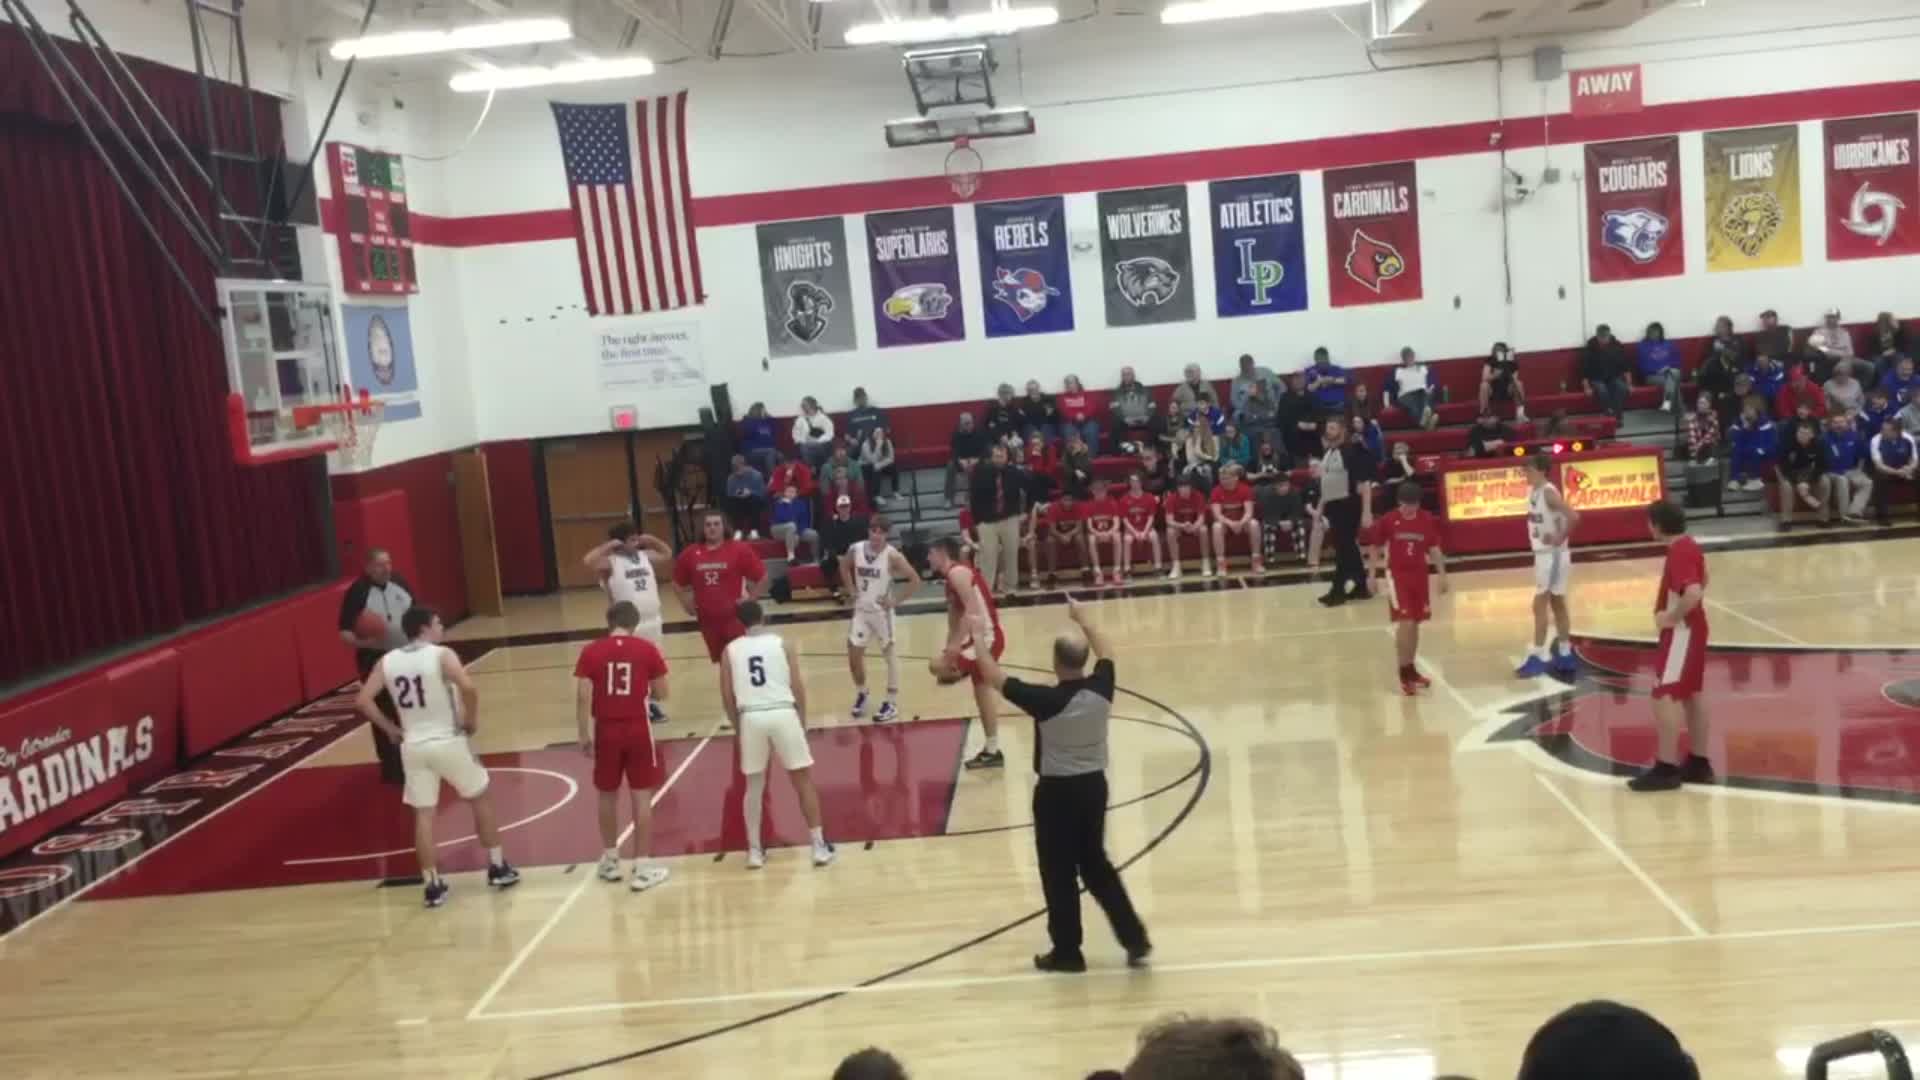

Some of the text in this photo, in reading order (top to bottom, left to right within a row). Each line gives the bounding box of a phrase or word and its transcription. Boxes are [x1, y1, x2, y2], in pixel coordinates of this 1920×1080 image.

[1577, 72, 1633, 96] AWAY
[1730, 151, 1774, 180] LIONS
[1834, 138, 1910, 170] HURRICANES
[1599, 160, 1667, 192] COUGARS
[1220, 197, 1294, 229] ATHLETICS
[1333, 186, 1409, 219] CARDINALS
[994, 221, 1049, 251] REBELS
[1106, 208, 1182, 240] WOLVERINES
[773, 242, 833, 272] KNIGHTS
[875, 230, 949, 261] SUPERLARKS
[704, 571, 720, 585] 52
[607, 661, 632, 696] 13
[748, 655, 767, 687] 5
[394, 674, 427, 709] 21
